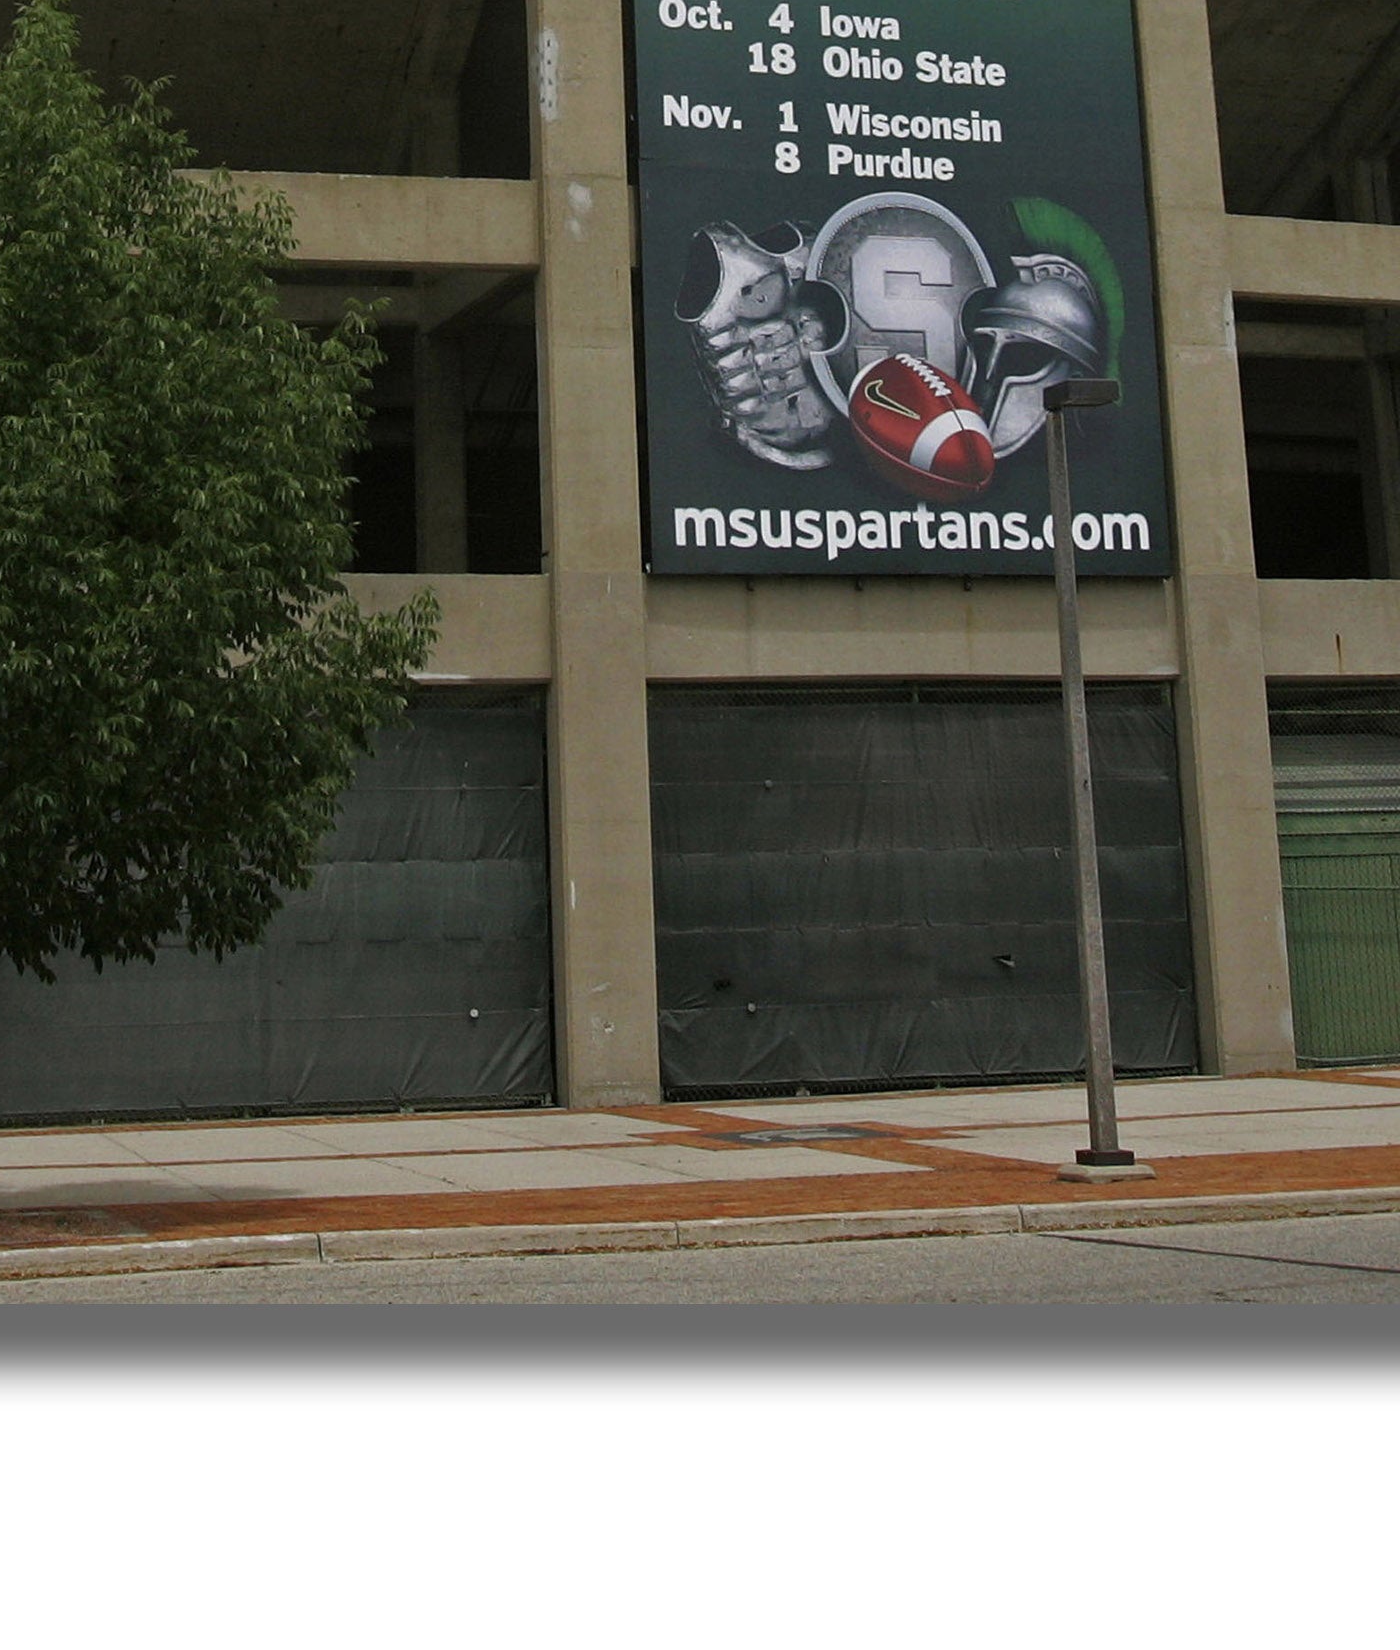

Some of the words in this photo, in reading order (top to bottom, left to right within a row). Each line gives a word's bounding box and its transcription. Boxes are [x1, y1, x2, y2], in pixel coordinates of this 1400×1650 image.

[768, 3, 795, 35] 4
[820, 6, 900, 41] Iowa
[748, 42, 797, 76] 18
[822, 48, 904, 83] Ohio
[915, 52, 1007, 87] State
[662, 95, 743, 130] Nov.
[778, 102, 799, 133] 1
[826, 103, 1003, 143] Wisconsin
[774, 142, 801, 175] 8
[827, 144, 956, 181] Purdue
